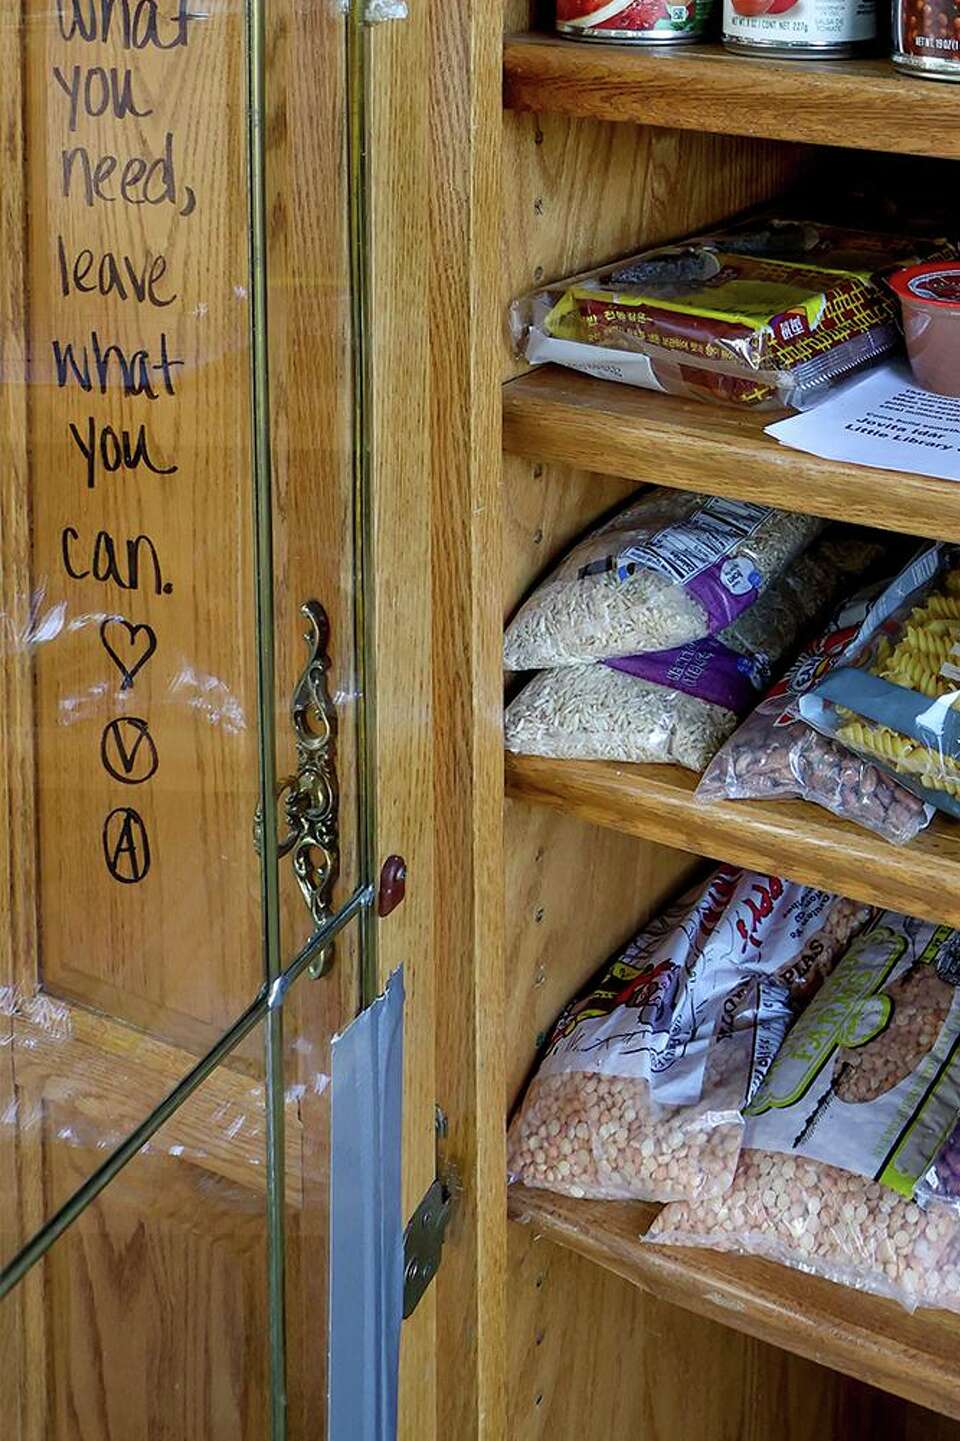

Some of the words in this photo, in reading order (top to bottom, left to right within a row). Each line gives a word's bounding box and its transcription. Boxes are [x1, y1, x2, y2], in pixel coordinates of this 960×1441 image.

[52, 65, 154, 131] you
[62, 131, 197, 217] need,
[57, 235, 178, 307] leave
[52, 333, 185, 399] what
[69, 416, 178, 488] you
[844, 425, 891, 436] Little
[892, 435, 953, 449] Library
[62, 526, 174, 594] can.
[780, 940, 826, 983] PEAS
